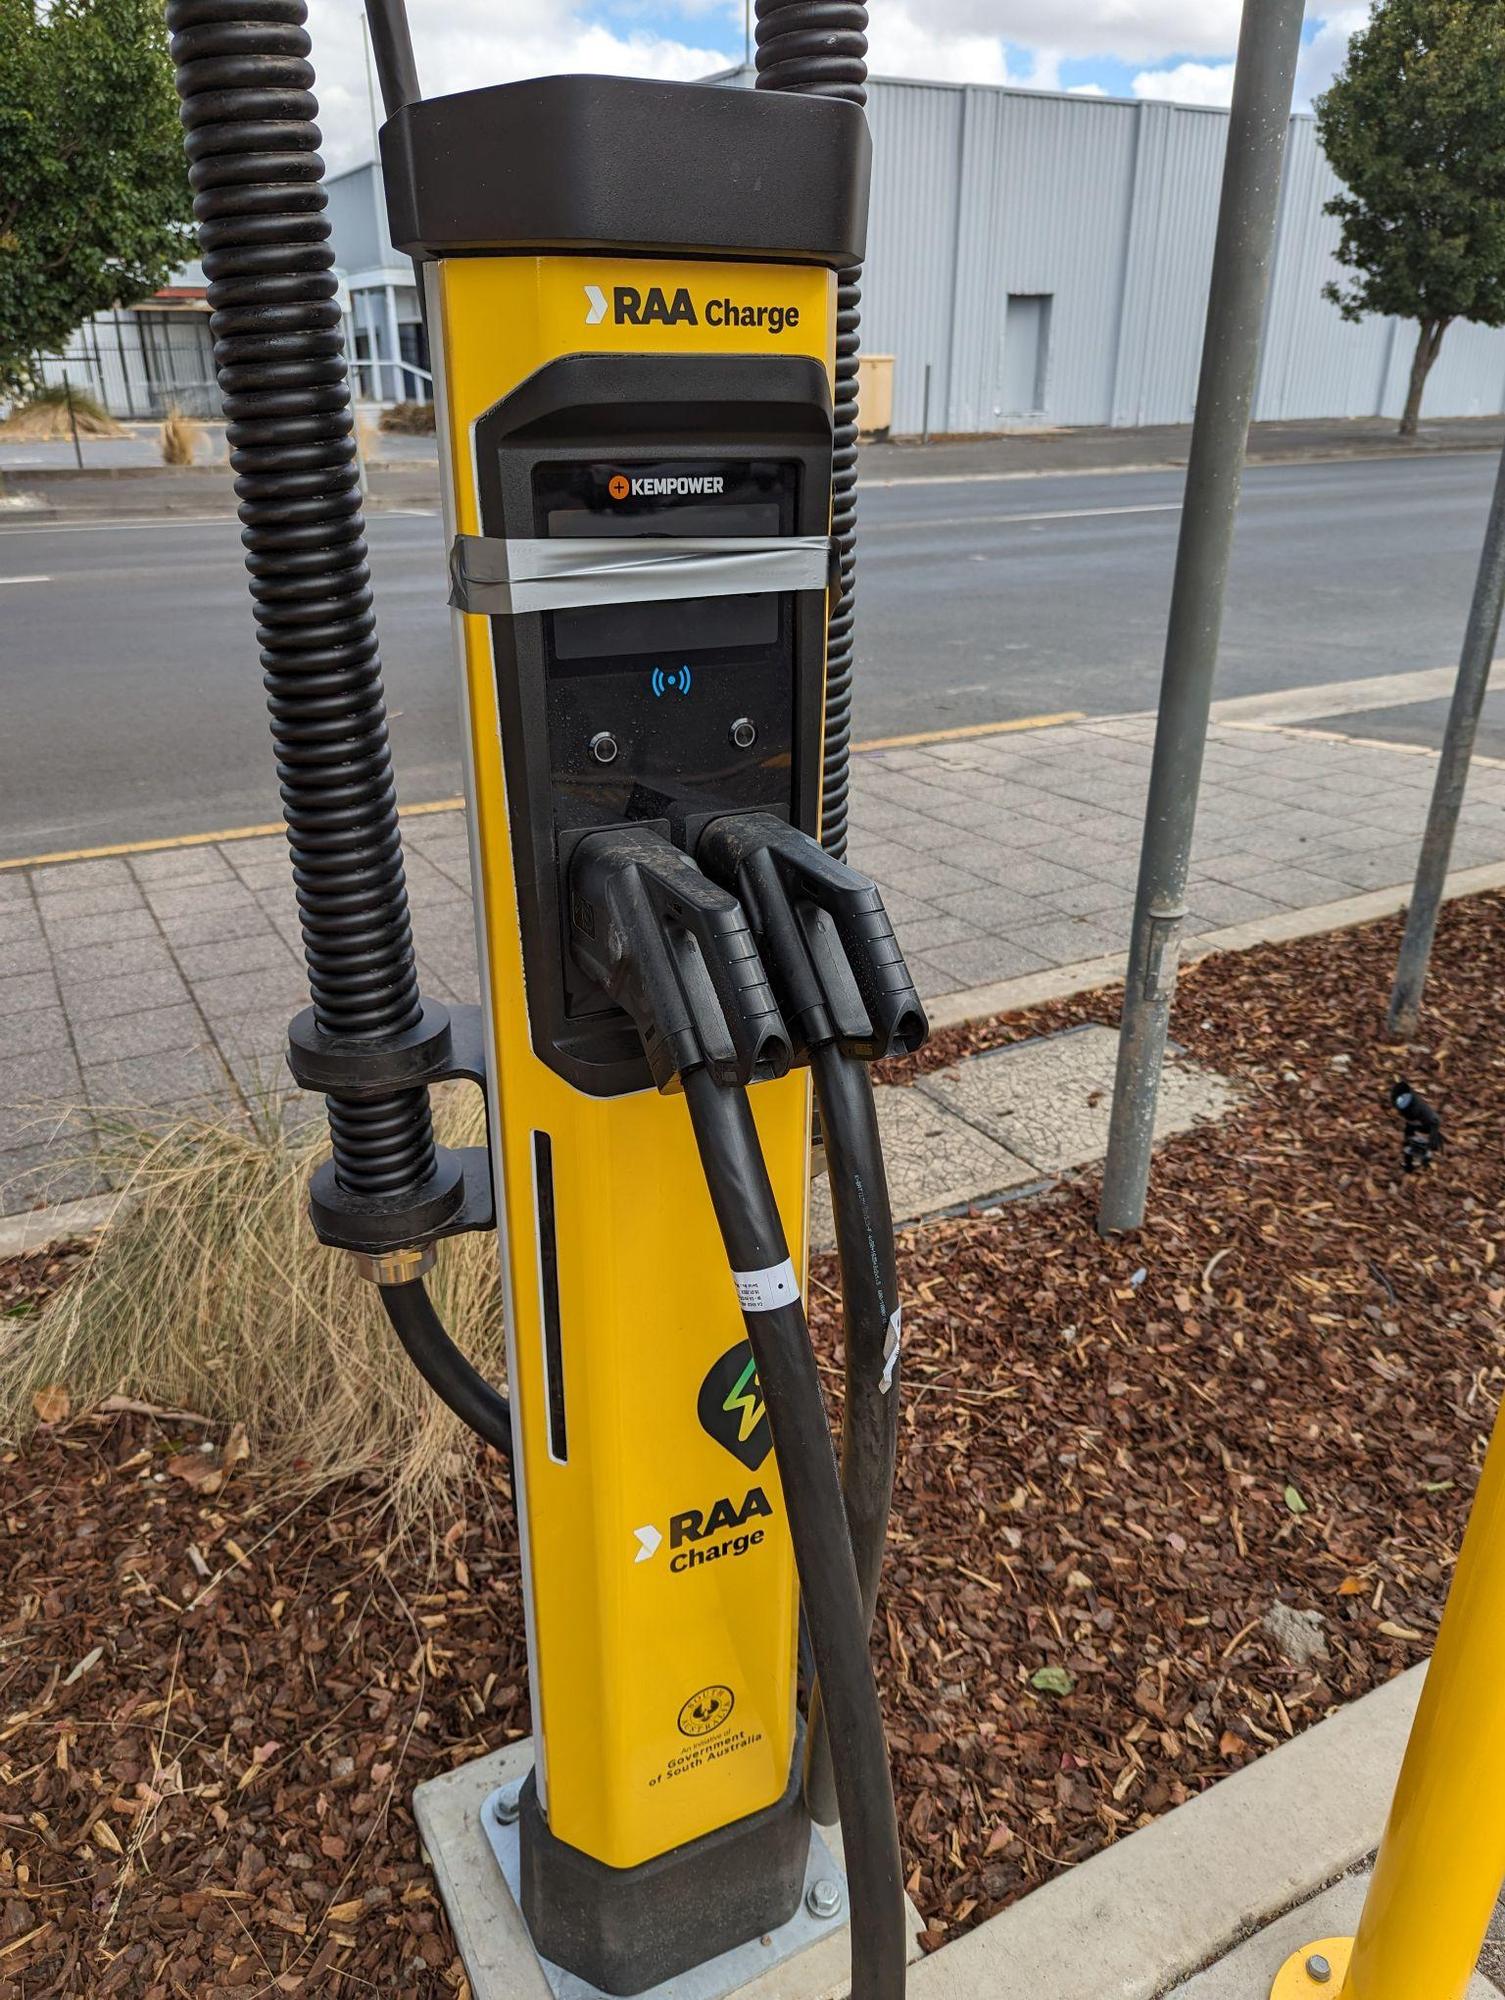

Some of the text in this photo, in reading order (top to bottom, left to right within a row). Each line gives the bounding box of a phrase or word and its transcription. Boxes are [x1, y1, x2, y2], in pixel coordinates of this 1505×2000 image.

[613, 286, 799, 334] RAA Charge
[631, 477, 724, 495] KEMPOWER
[669, 1487, 773, 1550] RAA
[669, 1529, 765, 1573] Charge
[648, 1733, 762, 1787] of South Australia
[667, 1731, 745, 1769] Government
